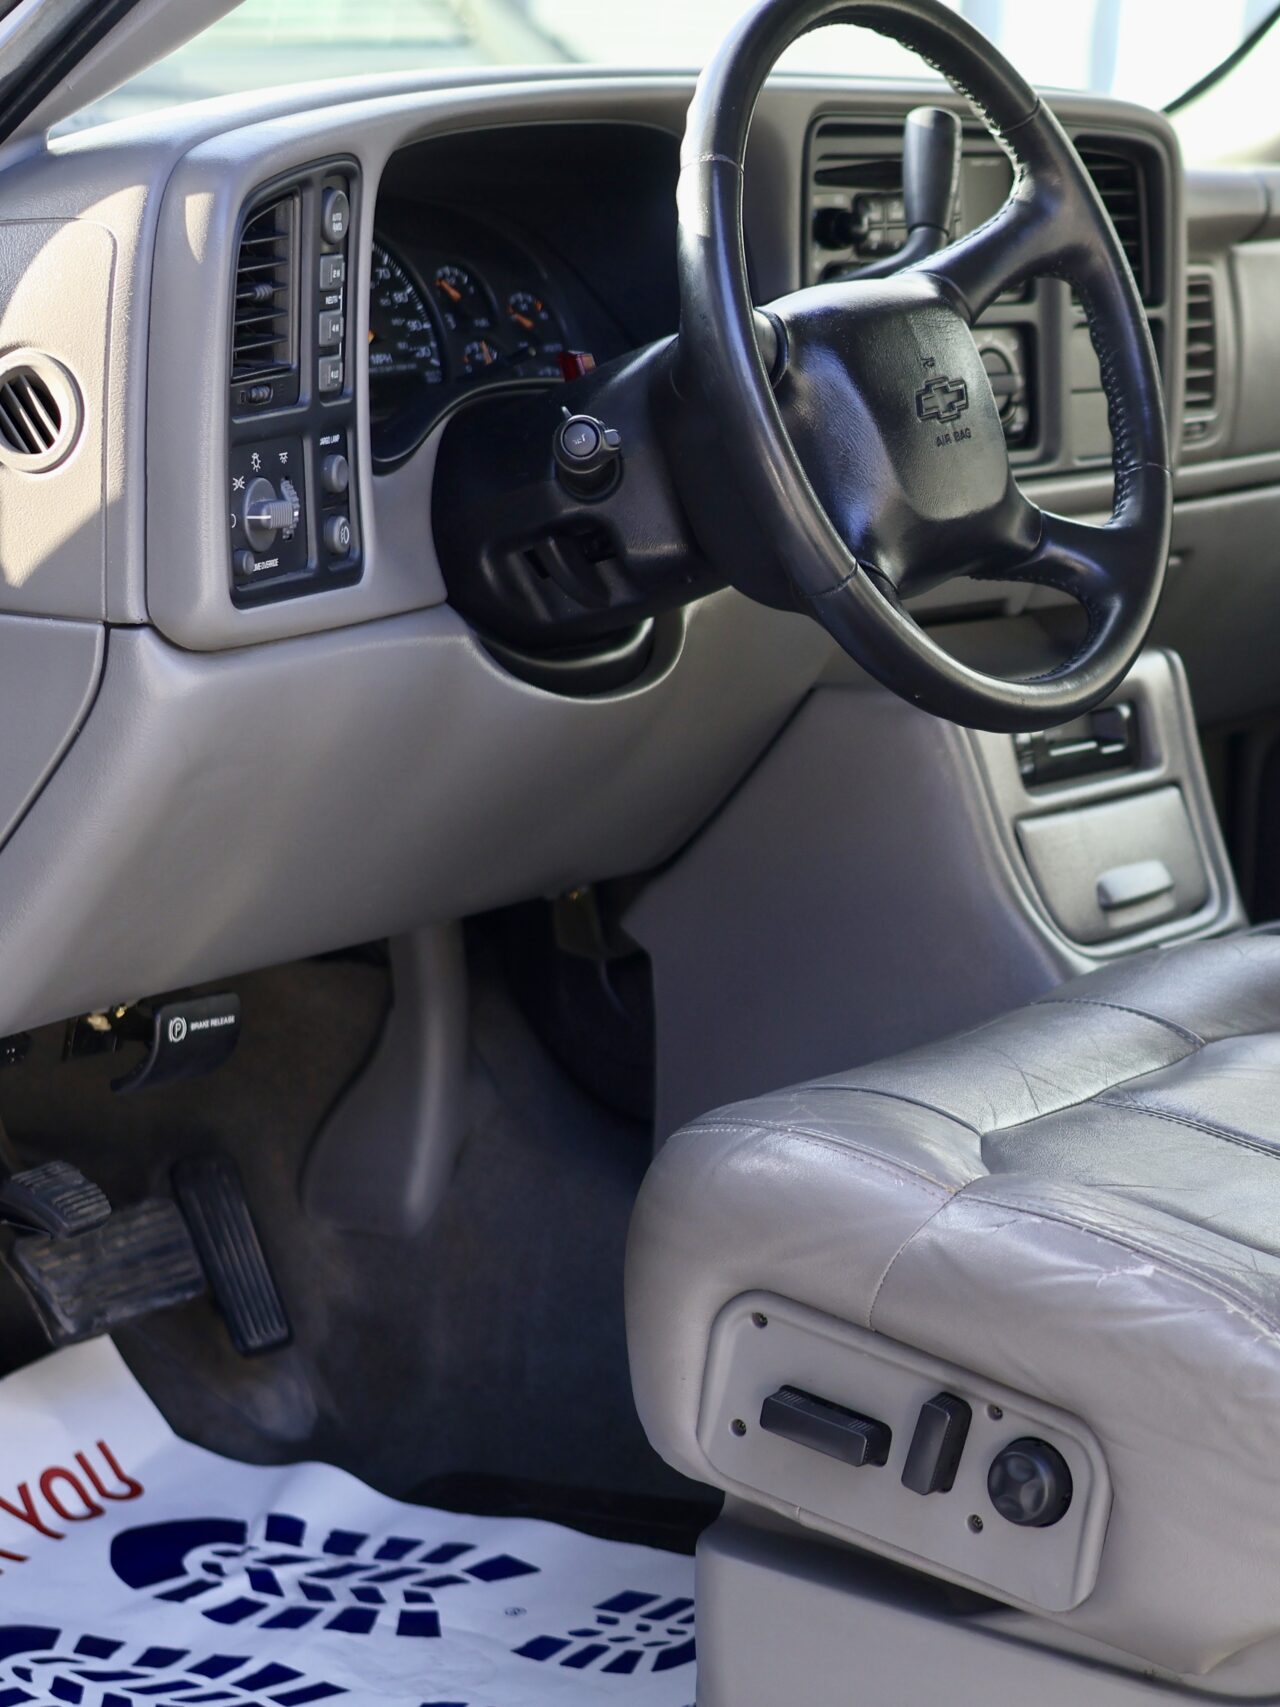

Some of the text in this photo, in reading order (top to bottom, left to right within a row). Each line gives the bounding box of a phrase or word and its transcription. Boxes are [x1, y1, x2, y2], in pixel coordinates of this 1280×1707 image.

[936, 428, 972, 447] AIR BAG
[190, 1021, 209, 1031] BRAKE
[210, 1015, 235, 1027] RELEASE
[0, 1438, 145, 1541] YOU
